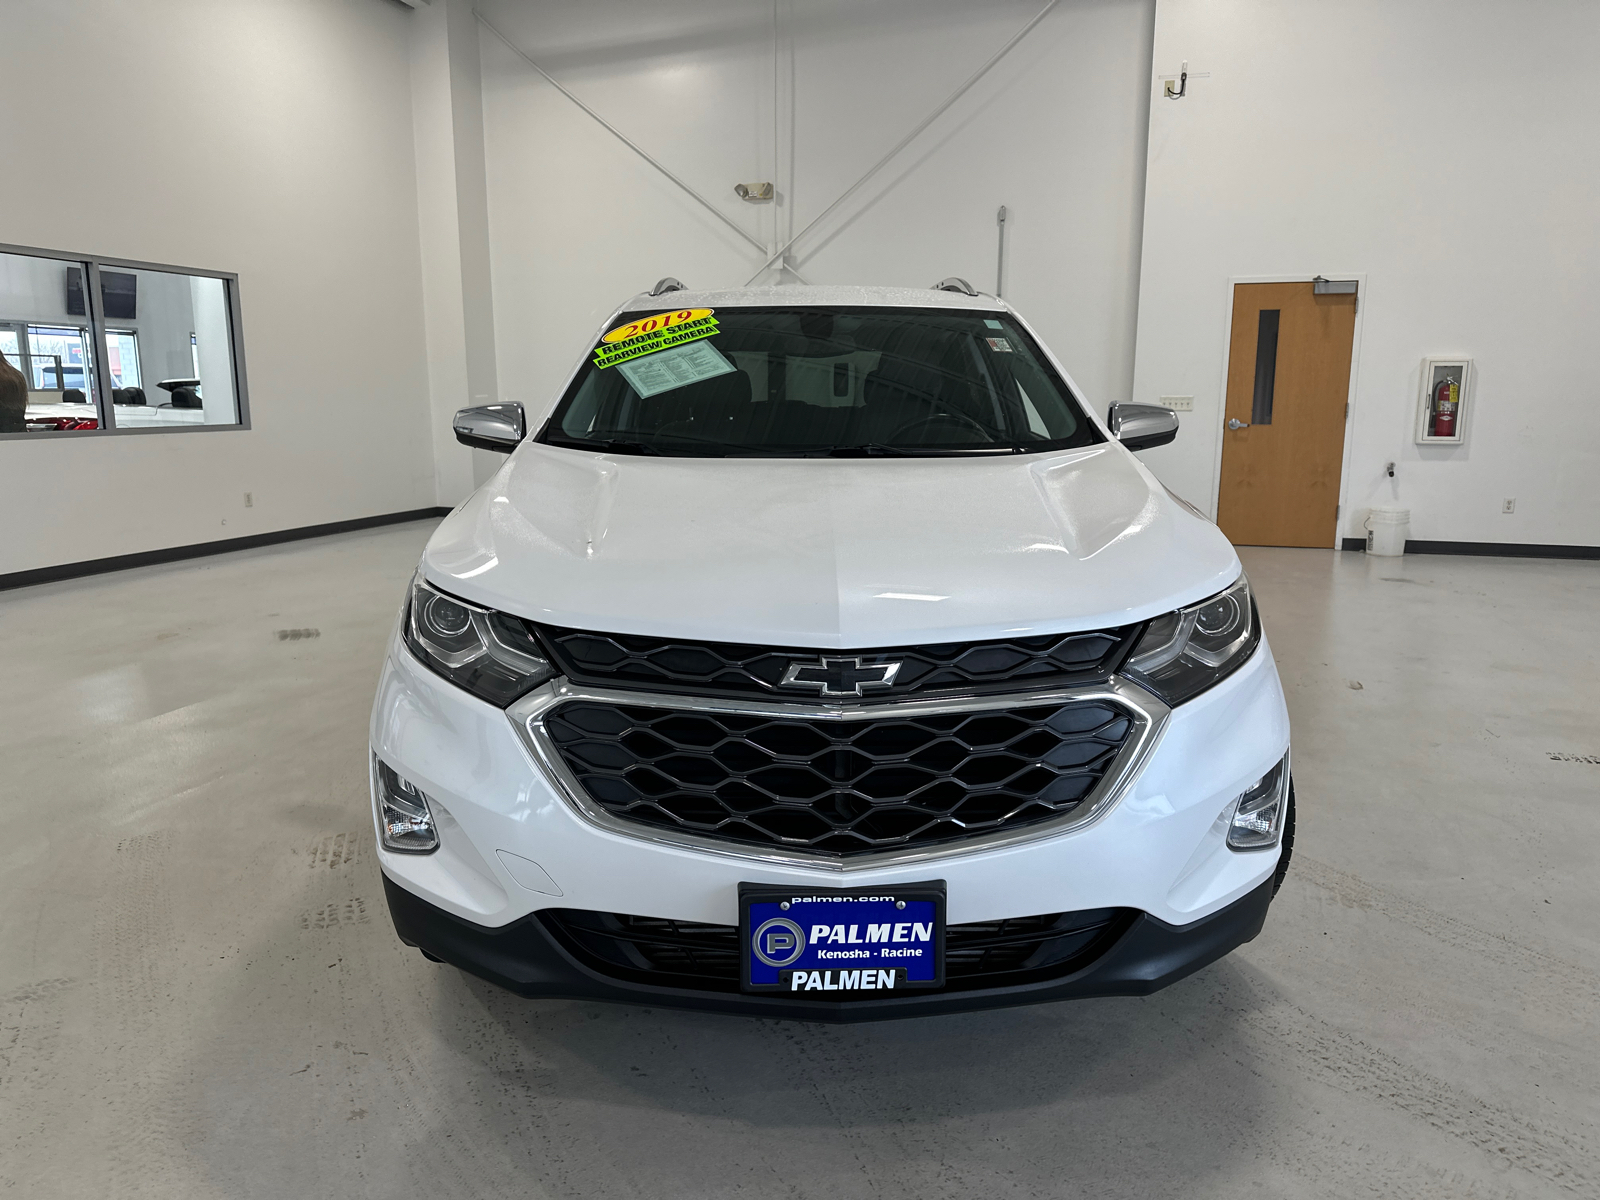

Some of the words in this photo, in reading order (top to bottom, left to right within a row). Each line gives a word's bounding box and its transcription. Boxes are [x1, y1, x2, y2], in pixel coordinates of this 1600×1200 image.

[624, 310, 692, 339] 2019
[597, 340, 662, 367] REARVIEW
[663, 326, 714, 345] CAMERA
[601, 330, 664, 355] REMOTE
[666, 317, 712, 335] START
[791, 895, 894, 903] palmen.com
[766, 933, 795, 954] P
[809, 922, 933, 944] PALMEN
[817, 949, 870, 959] Kenosha
[881, 948, 923, 958] Racine
[791, 969, 896, 990] PALMEN
